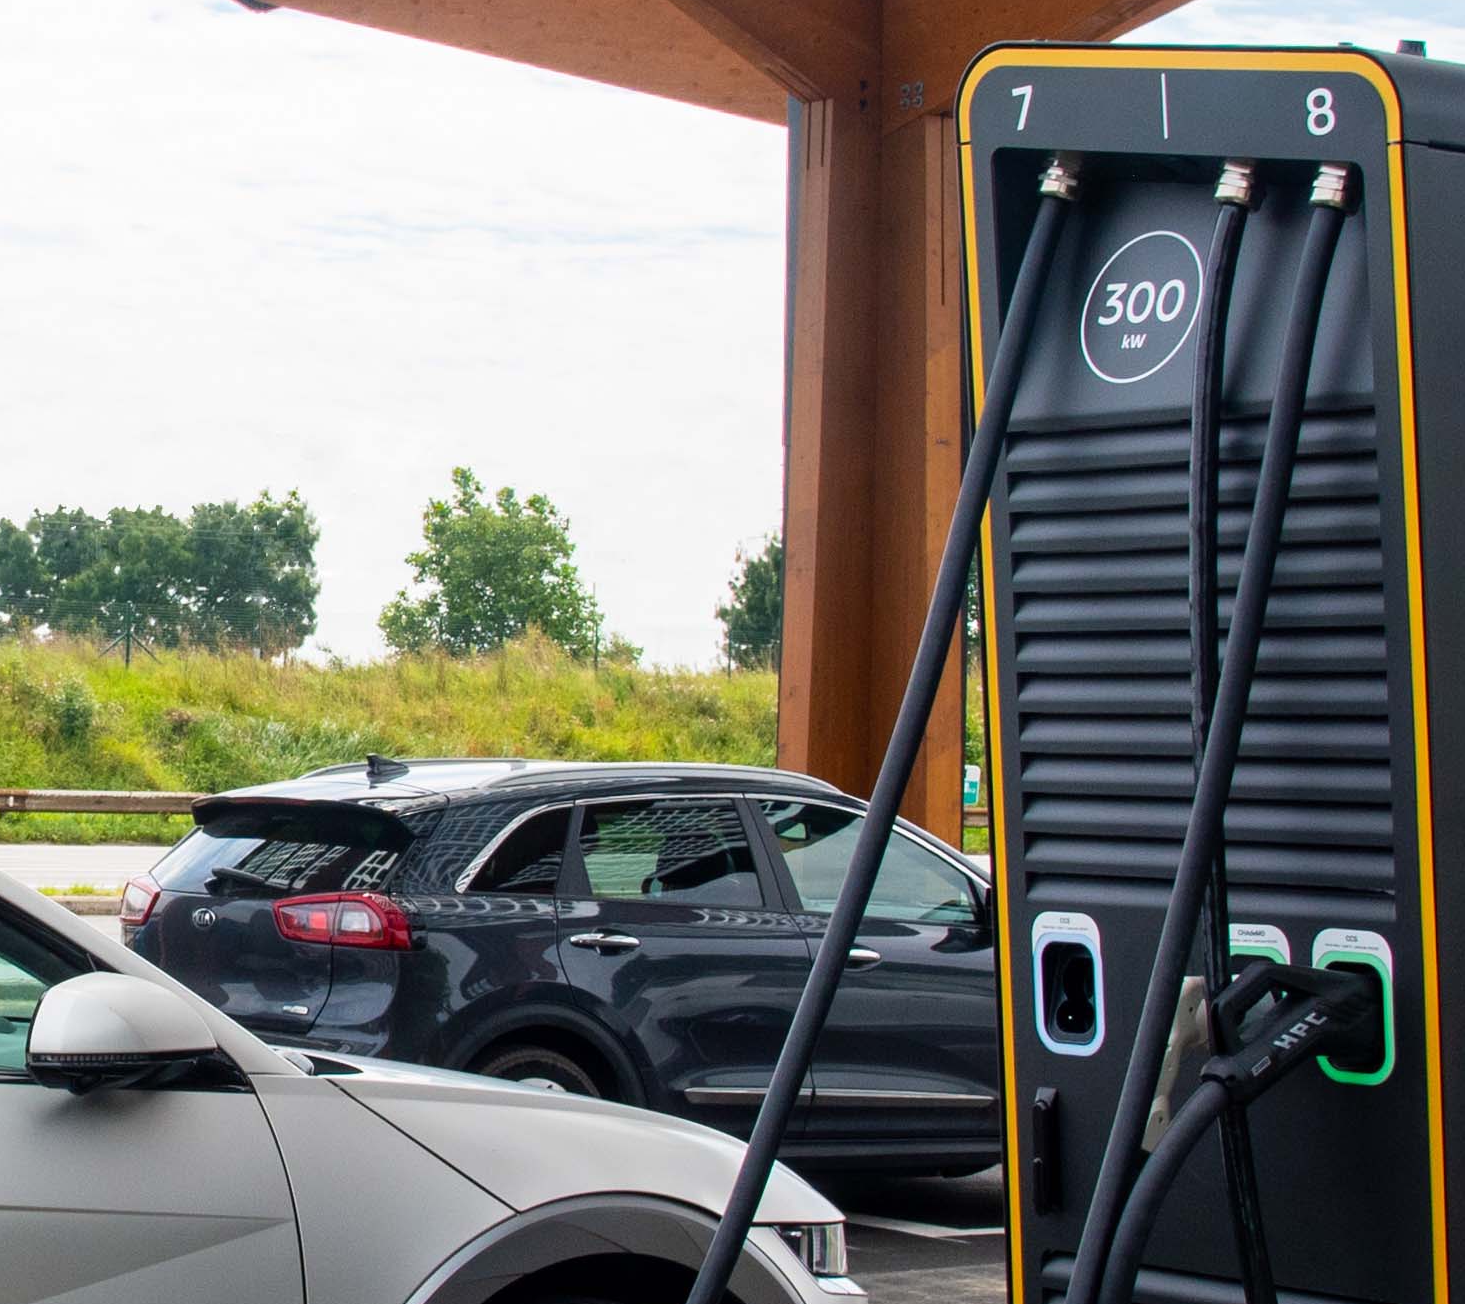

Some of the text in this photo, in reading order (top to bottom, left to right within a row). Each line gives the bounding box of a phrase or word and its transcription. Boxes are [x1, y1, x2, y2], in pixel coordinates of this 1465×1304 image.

[1011, 84, 1336, 137] 7 8
[1097, 278, 1186, 326] 300
[1120, 333, 1148, 350] kW
[1273, 1012, 1328, 1050] HPC
